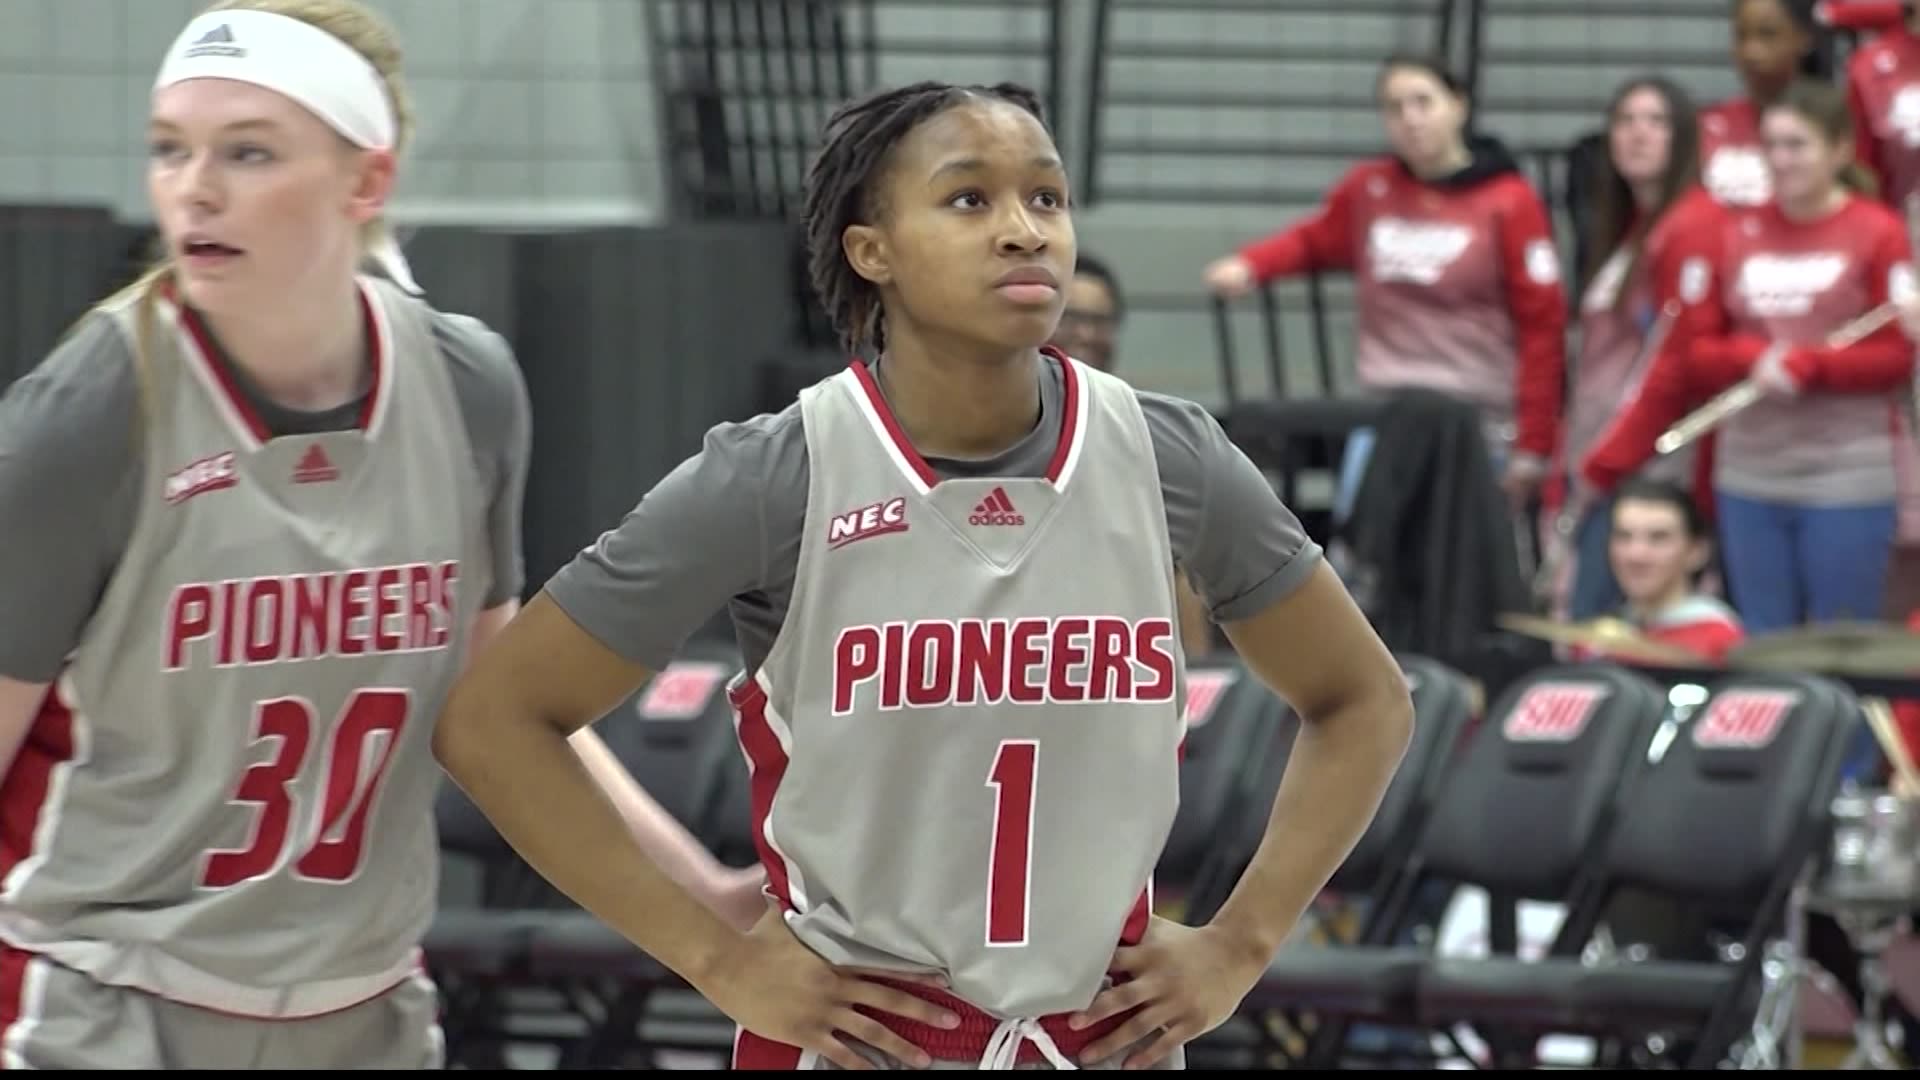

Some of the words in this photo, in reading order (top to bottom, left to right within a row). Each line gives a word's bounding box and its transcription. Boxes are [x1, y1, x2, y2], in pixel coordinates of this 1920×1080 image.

[828, 497, 906, 543] NEC
[968, 513, 1025, 526] adidas
[160, 560, 461, 673] PIONEERS
[831, 615, 1177, 717] PIONEERS
[193, 687, 414, 891] 30
[985, 739, 1040, 948] 1
